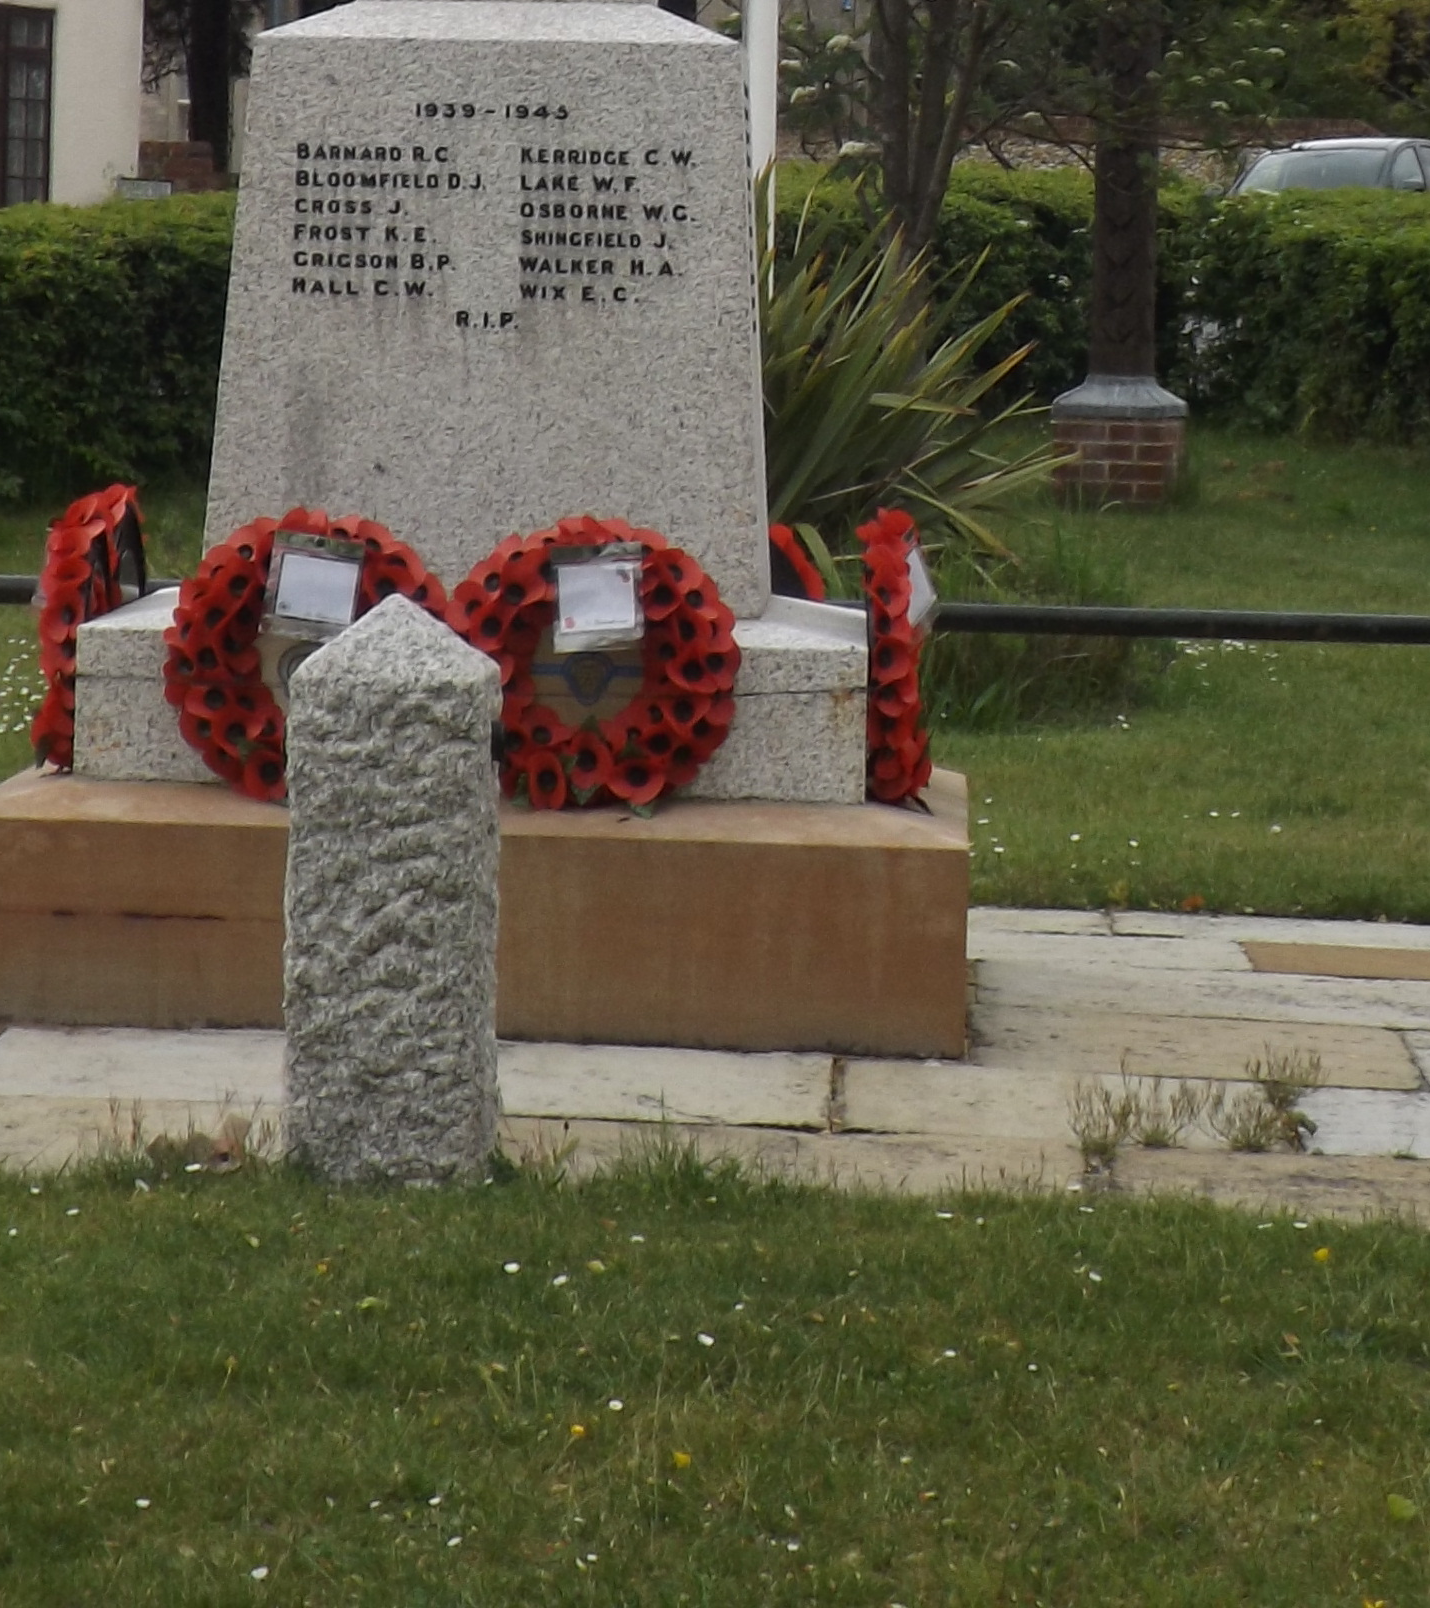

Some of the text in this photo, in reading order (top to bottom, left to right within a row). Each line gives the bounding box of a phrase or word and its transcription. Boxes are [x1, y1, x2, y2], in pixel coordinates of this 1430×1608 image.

[297, 143, 401, 161] BARNARD
[521, 147, 630, 166] KERRIDGE
[295, 170, 486, 190] BLOOMFIELD D.J.
[520, 175, 640, 193] LAKE W.F.
[295, 198, 409, 216] CROSS J.
[520, 202, 629, 221] OSBORNE
[294, 224, 437, 242] FROST K.E.
[521, 229, 674, 250] SHINGFIELD J.
[410, 253, 456, 271] B.P.
[519, 257, 614, 276] WALKER
[292, 278, 359, 295] HALL
[520, 284, 566, 301] WIX
[455, 310, 519, 330] R.I.P.
